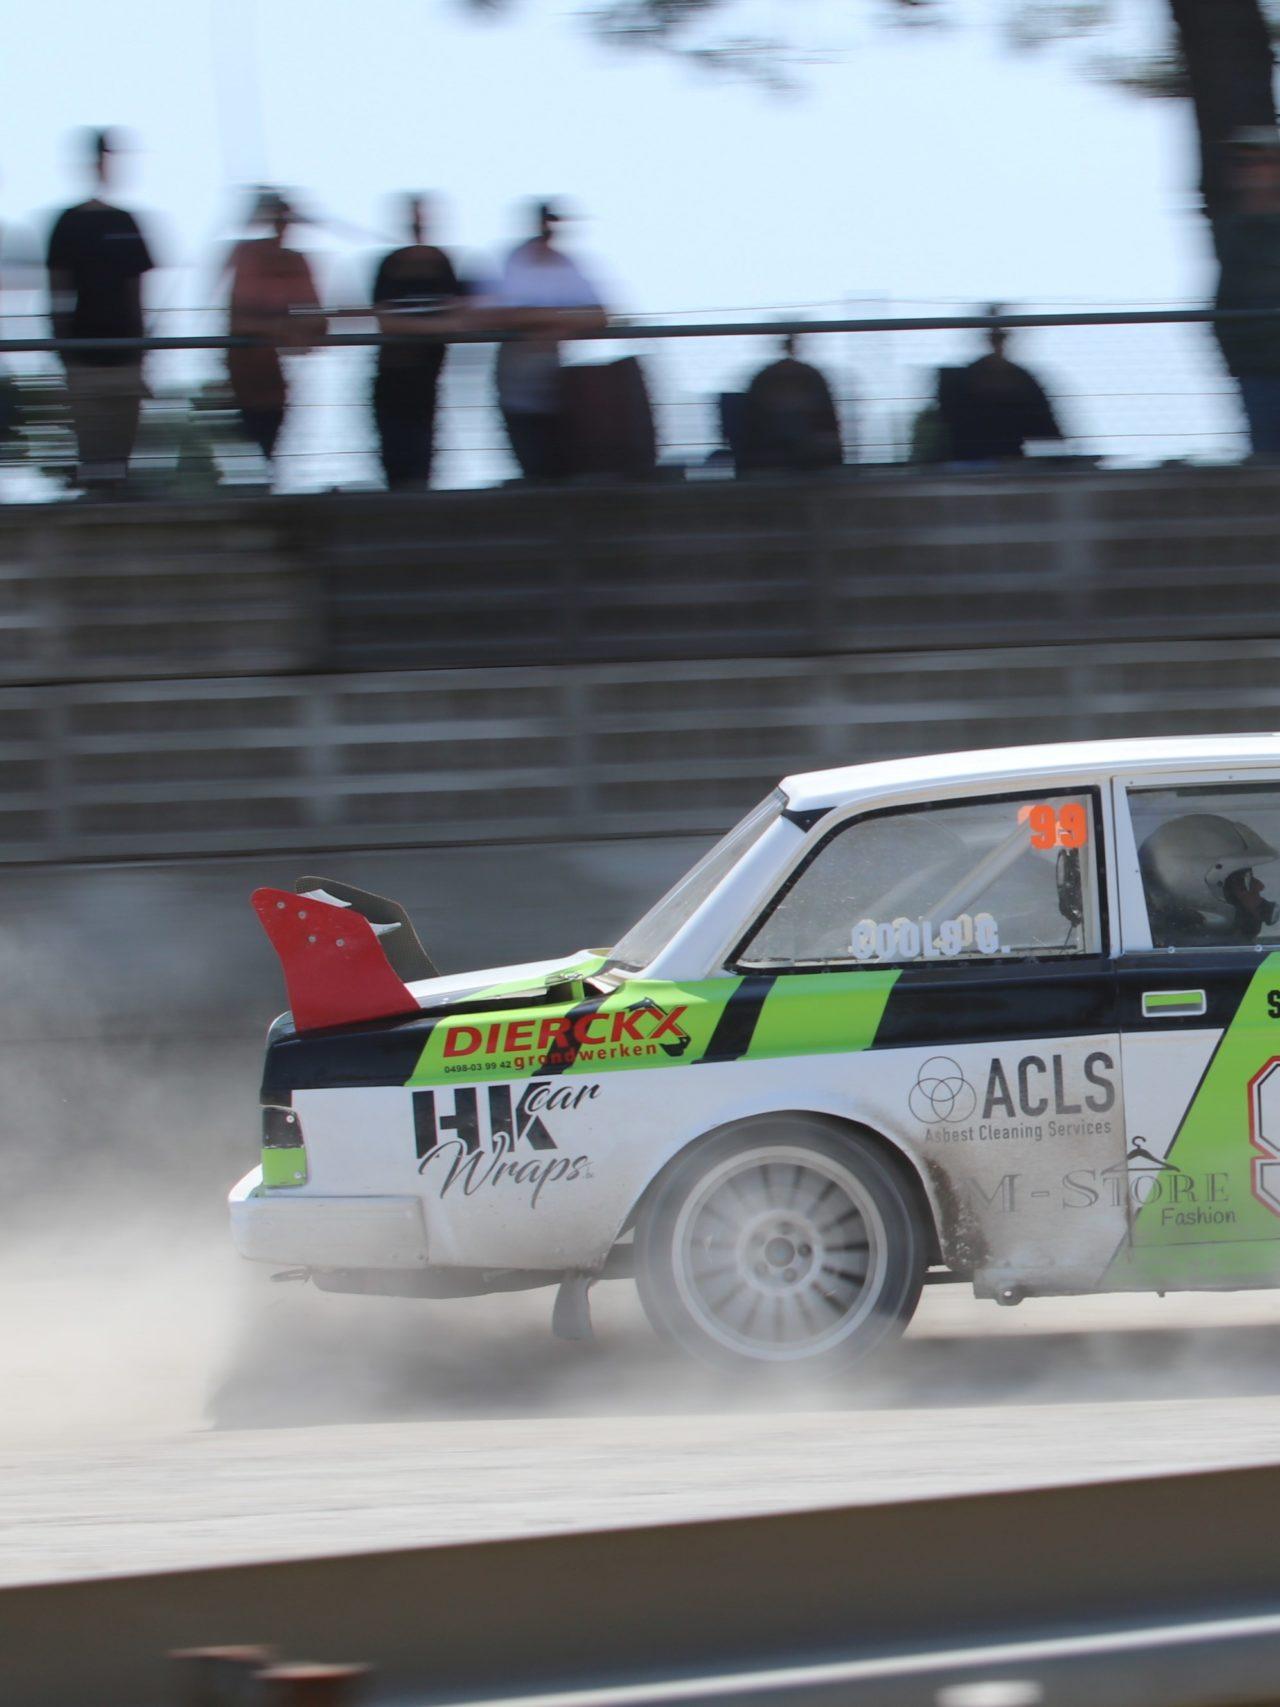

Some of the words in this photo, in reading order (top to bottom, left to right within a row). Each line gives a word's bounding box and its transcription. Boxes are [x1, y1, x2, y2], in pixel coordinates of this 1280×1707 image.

[1029, 803, 1086, 849] 99
[443, 1006, 689, 1058] DIERCKX
[514, 1043, 657, 1071] grondwerken
[982, 1052, 1116, 1119] ACLS
[412, 1081, 558, 1160] HK
[925, 1127, 974, 1144] Asbest
[979, 1122, 1043, 1141] Cleaning
[1049, 1120, 1112, 1137] Services
[418, 1131, 588, 1209] Wraps
[1161, 1207, 1236, 1227] Fashion
